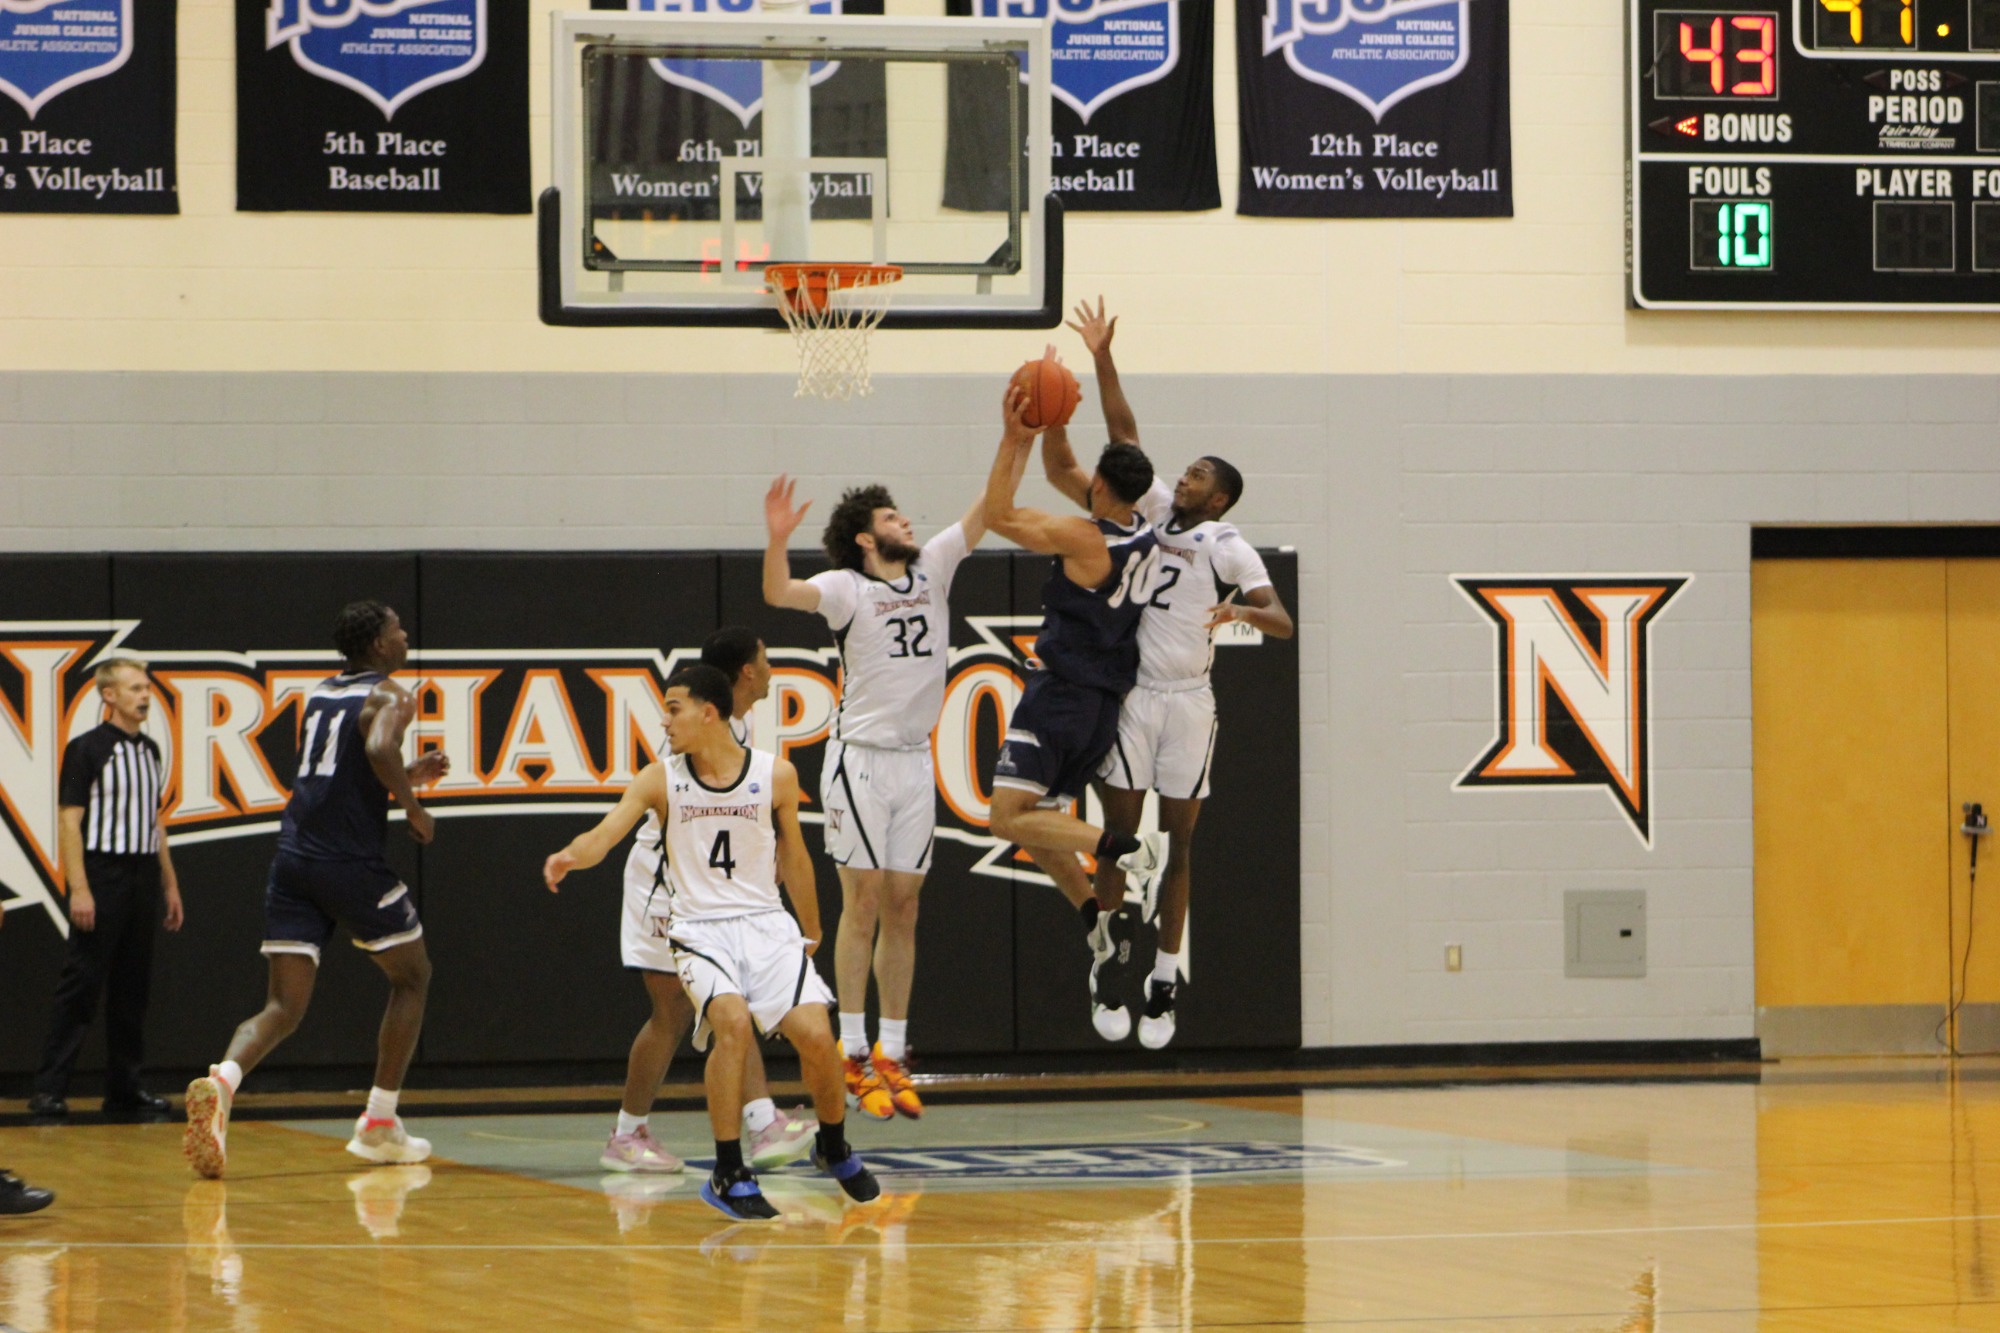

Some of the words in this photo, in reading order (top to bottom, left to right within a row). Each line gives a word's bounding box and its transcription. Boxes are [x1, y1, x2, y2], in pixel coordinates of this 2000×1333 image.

[52, 10, 117, 21] NATIONAL
[409, 14, 472, 25] NATIONAL
[1104, 20, 1164, 31] NATIONAL
[1396, 20, 1454, 31] NATIONAL
[13, 24, 60, 36] JUNIOR
[63, 25, 117, 36] COLLEGE
[370, 28, 416, 39] JUNIOR
[419, 29, 472, 40] COLLEGE
[1066, 34, 1111, 45] JUNIOR
[1114, 35, 1164, 46] COLLEGE
[1360, 34, 1402, 45] JUNIOR
[1405, 35, 1454, 46] COLLEGE
[41, 41, 118, 52] ASSOCIATION
[341, 43, 395, 54] ATHLETIC
[398, 44, 472, 56] ASSOCIATION
[1052, 49, 1091, 60] HLETIC
[1093, 50, 1164, 61] ASSOCIATION
[1332, 49, 1382, 60] ATHLETIC
[1385, 50, 1454, 61] ASSOCIATION
[1679, 17, 1774, 94] 43
[1890, 69, 1941, 92] POSS
[1868, 96, 1964, 124] PERIOD
[1703, 113, 1792, 142] BONUS
[1879, 125, 1939, 138] Fair-Play
[20, 130, 92, 155] Place
[322, 132, 366, 155] 5th
[376, 132, 447, 156] Place
[680, 139, 722, 162] 6th
[1073, 134, 1141, 158] Place
[1309, 133, 1363, 157] 12th
[1372, 134, 1439, 157] Place
[26, 166, 164, 200] Volleyball
[328, 166, 441, 191] Baseball
[611, 173, 719, 198] Women'
[1051, 168, 1135, 192] aseball
[1252, 166, 1364, 190] Women's
[1373, 167, 1498, 200] Volleyball
[1688, 166, 1773, 195] FOULS
[1855, 169, 1953, 198] PLAYER
[1717, 203, 1771, 267] 10
[885, 613, 933, 659] 32
[1230, 623, 1256, 637] TM
[1449, 572, 1696, 852] N
[297, 709, 346, 778] 11
[680, 803, 759, 823] NORTHAMPTON
[708, 829, 736, 880] 4
